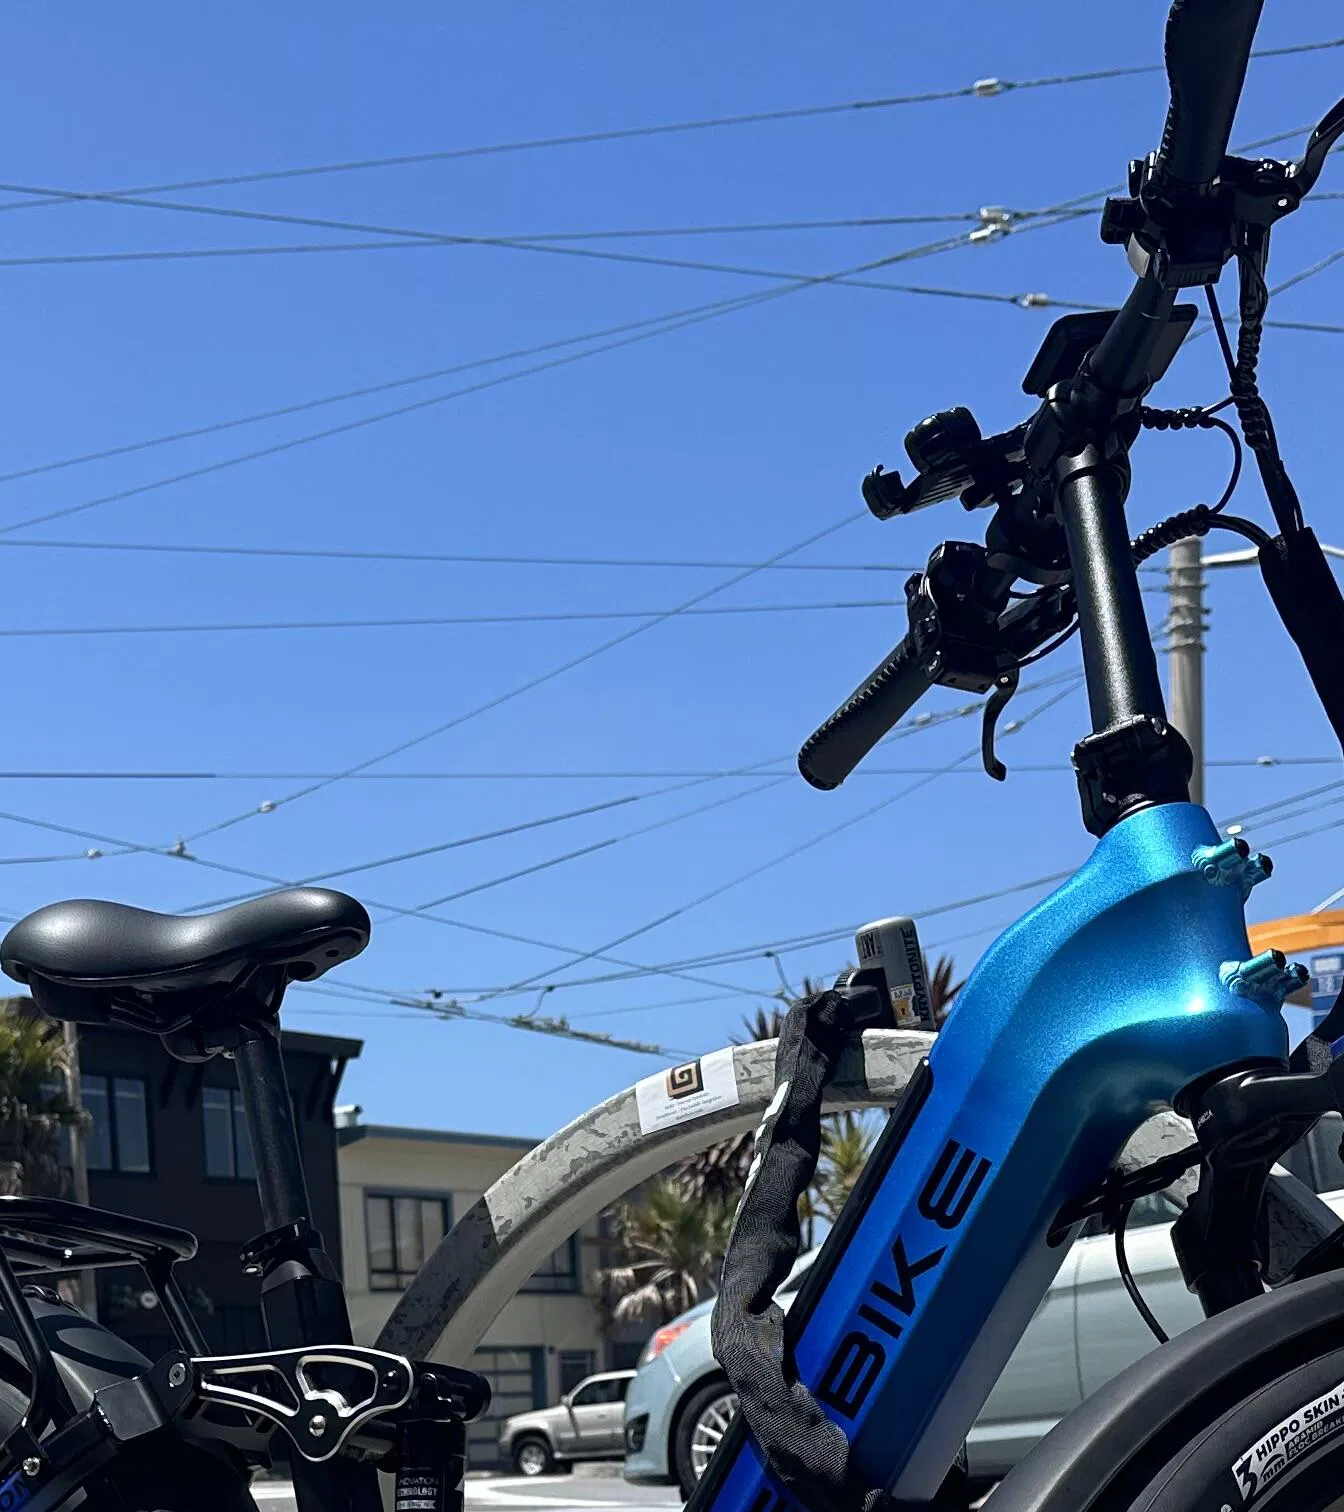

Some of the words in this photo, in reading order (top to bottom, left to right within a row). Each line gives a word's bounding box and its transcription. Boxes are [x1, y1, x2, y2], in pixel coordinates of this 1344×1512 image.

[900, 926, 931, 1021] KRYPTONITE
[1255, 1419, 1301, 1461] HIPPO
[1303, 1394, 1340, 1424] SKIN
[1288, 1420, 1324, 1450] ARAMID
